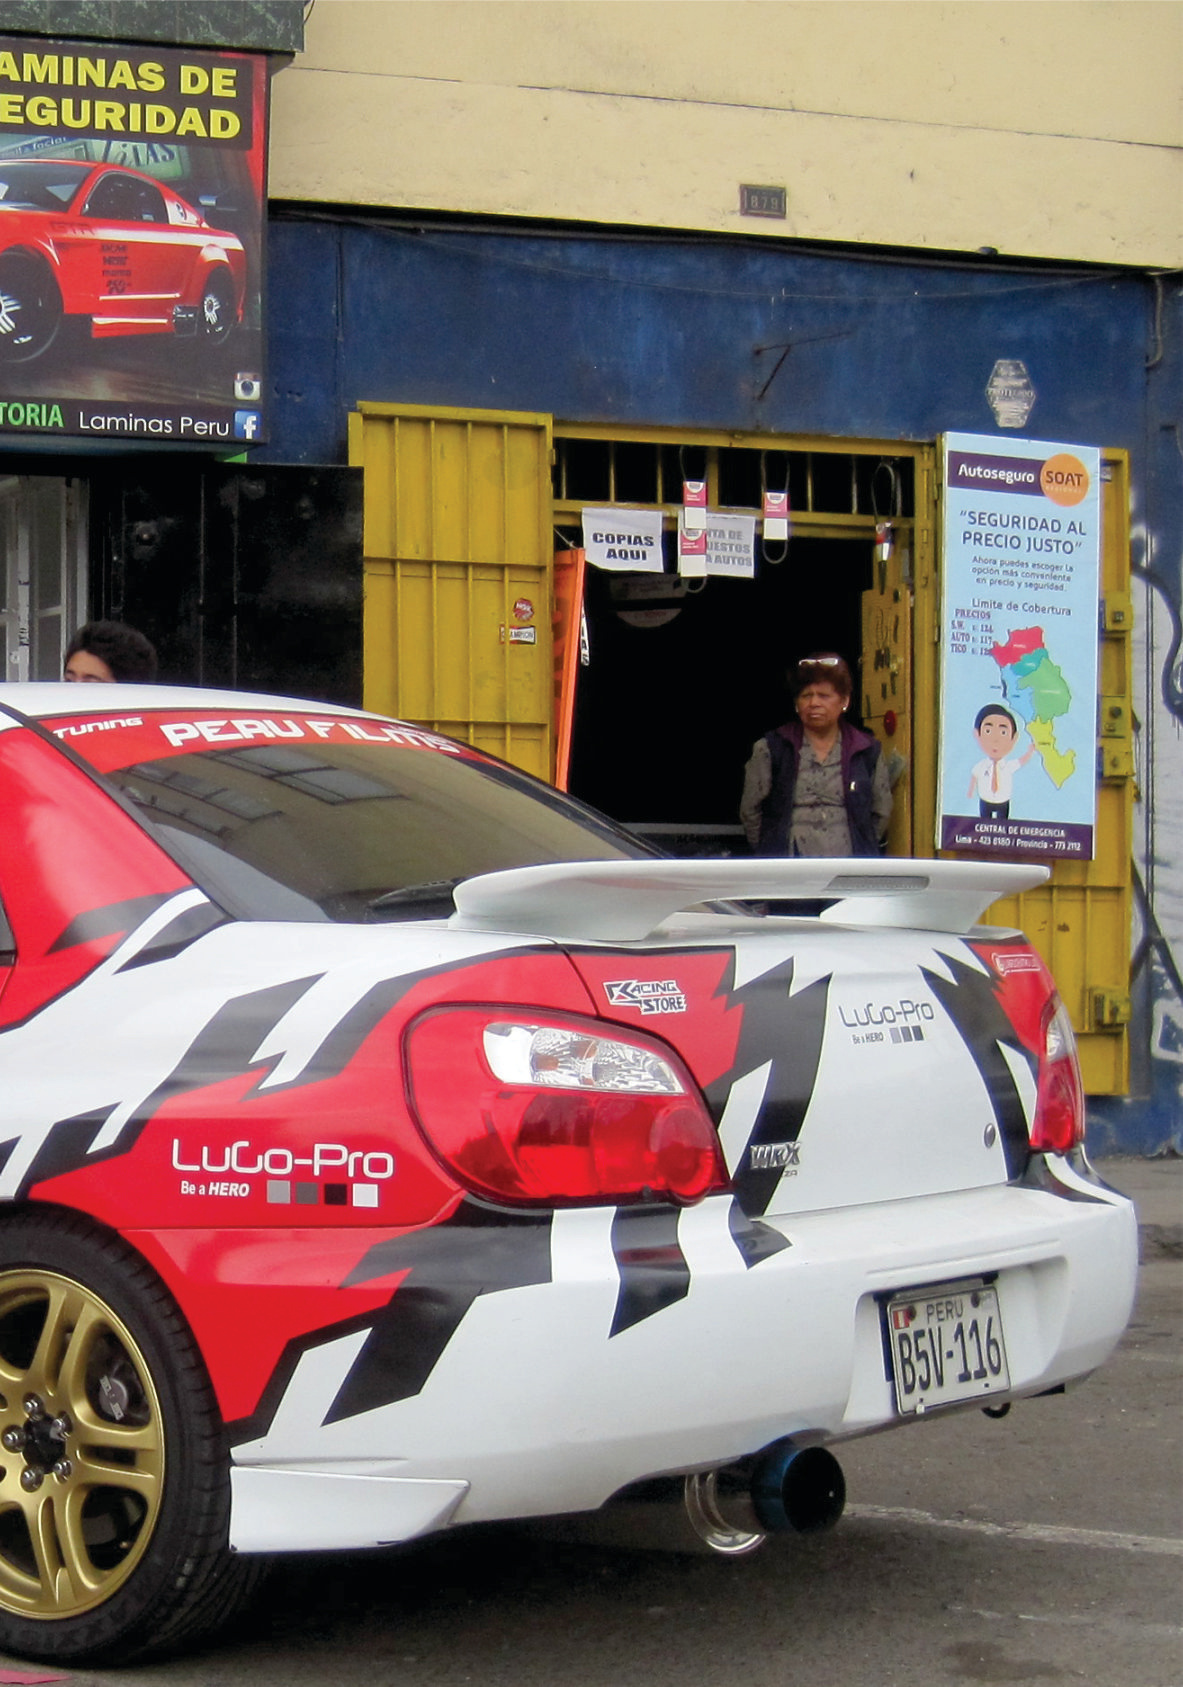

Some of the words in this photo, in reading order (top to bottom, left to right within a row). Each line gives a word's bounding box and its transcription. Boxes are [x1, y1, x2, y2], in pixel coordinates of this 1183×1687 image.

[179, 64, 238, 98] DE
[79, 411, 173, 434] Laminas
[180, 416, 230, 437] Peru
[958, 463, 1036, 485] Autoseguro
[1045, 470, 1084, 487] SOAT
[1066, 520, 1087, 536] AL
[592, 532, 654, 547] COPIAS
[962, 531, 1021, 549] PRECIO
[606, 548, 647, 561] AQUI
[972, 556, 997, 565] Ahora
[1000, 558, 1029, 568] puedes
[1032, 562, 1063, 572] escoger
[976, 577, 987, 585] en
[989, 578, 1015, 587] precio
[1021, 570, 1072, 582] conveniente
[955, 608, 991, 620] PRECIOS
[1006, 602, 1019, 611] de
[1022, 602, 1072, 616] Cobertura
[951, 632, 971, 642] AUTO
[158, 719, 305, 748] PERU
[975, 823, 1006, 834] CENTRAL
[1008, 826, 1018, 835] DE
[1020, 826, 1066, 838] EMERGENCIA
[955, 834, 972, 844] Lima
[1016, 838, 1048, 849] Provincia
[640, 996, 685, 1013] STORE
[180, 1180, 196, 1195] Be
[198, 1185, 206, 1196] a
[208, 1181, 250, 1197] HERO
[926, 1299, 964, 1324] PERU
[898, 1316, 1002, 1395] B5V-116
